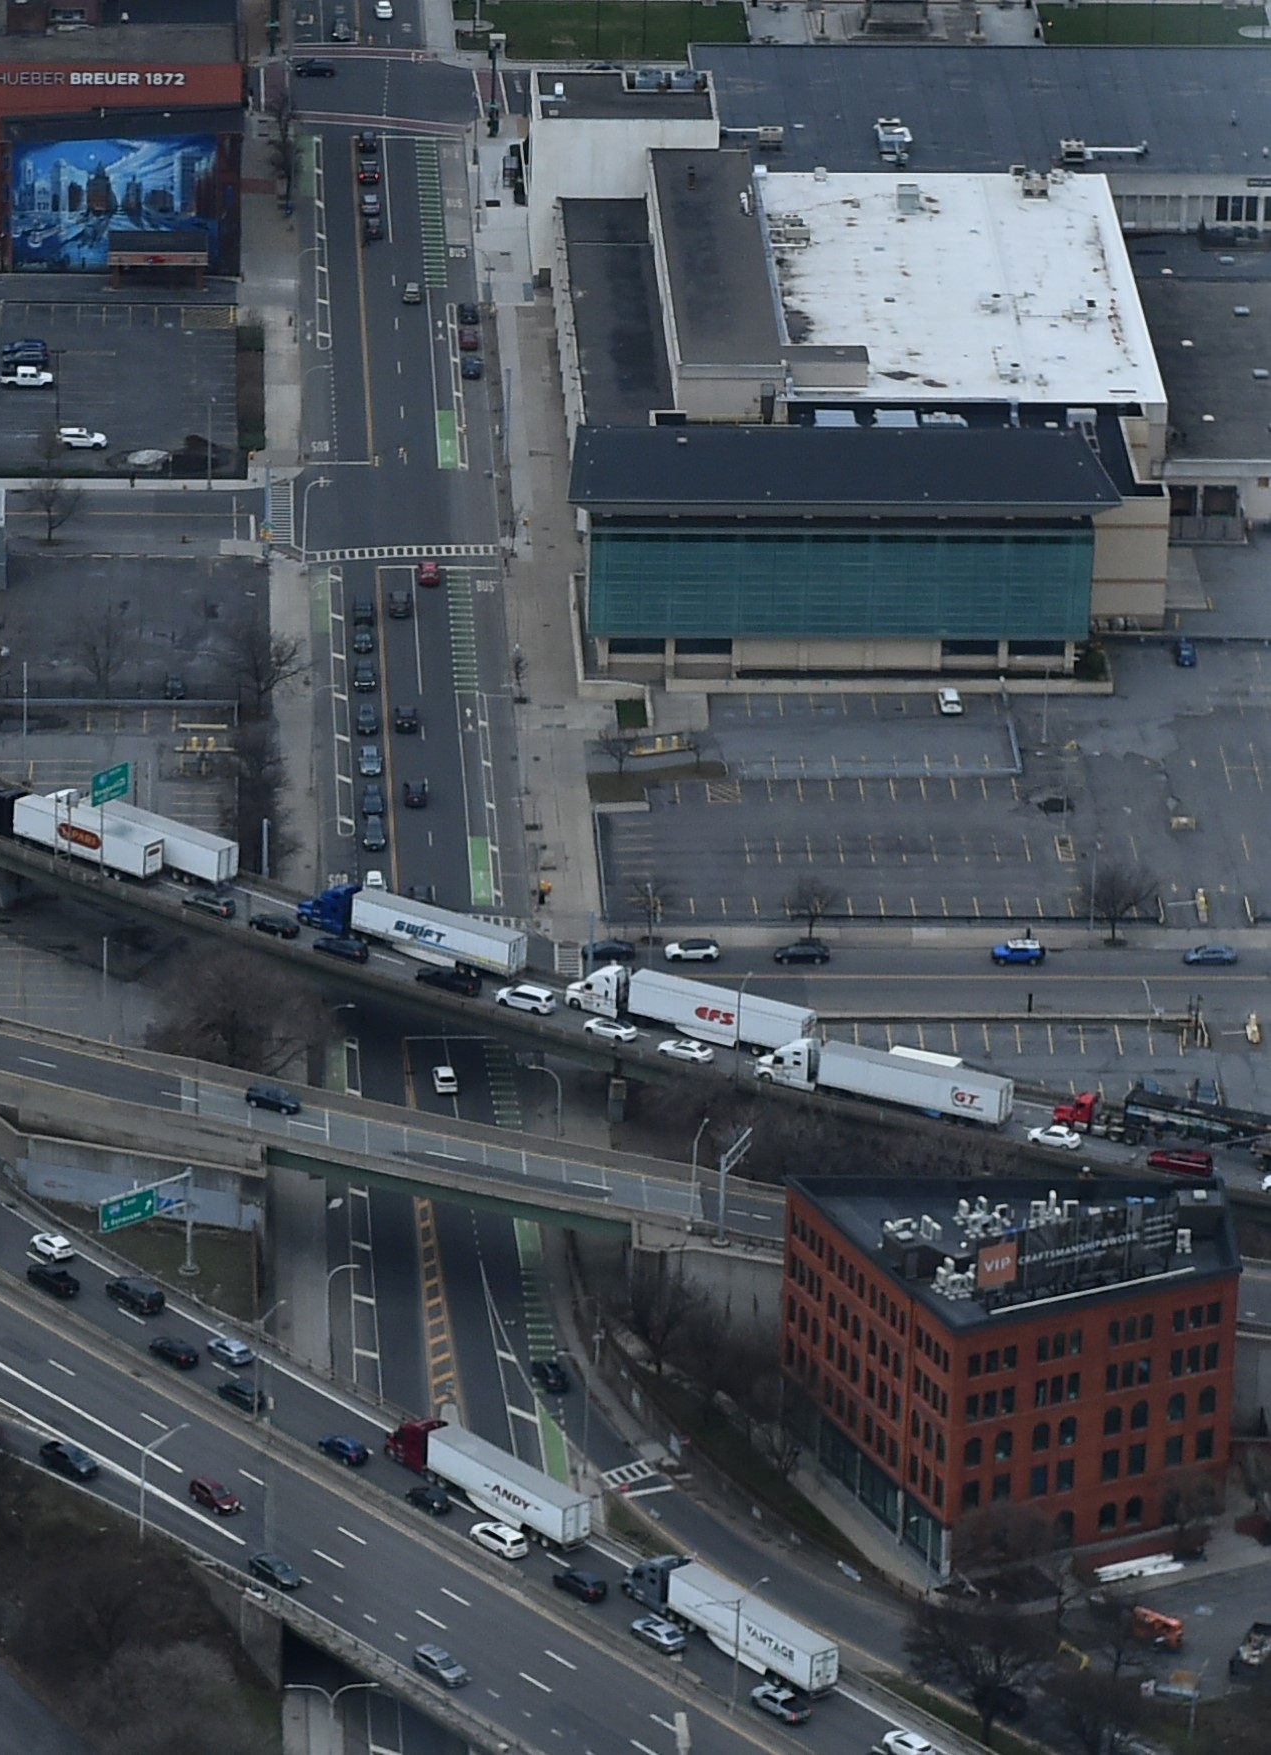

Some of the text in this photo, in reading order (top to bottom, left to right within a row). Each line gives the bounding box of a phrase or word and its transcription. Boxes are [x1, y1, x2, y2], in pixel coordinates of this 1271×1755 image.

[70, 72, 139, 85] BREUER
[145, 72, 185, 85] 1872
[449, 248, 466, 258] BUS
[476, 580, 494, 592] BUS
[394, 920, 446, 943] SWIFT
[955, 1092, 980, 1104] GT
[984, 1256, 1010, 1273] VIP
[492, 1485, 530, 1510] ANDY
[746, 1623, 794, 1661] VANTAGE
